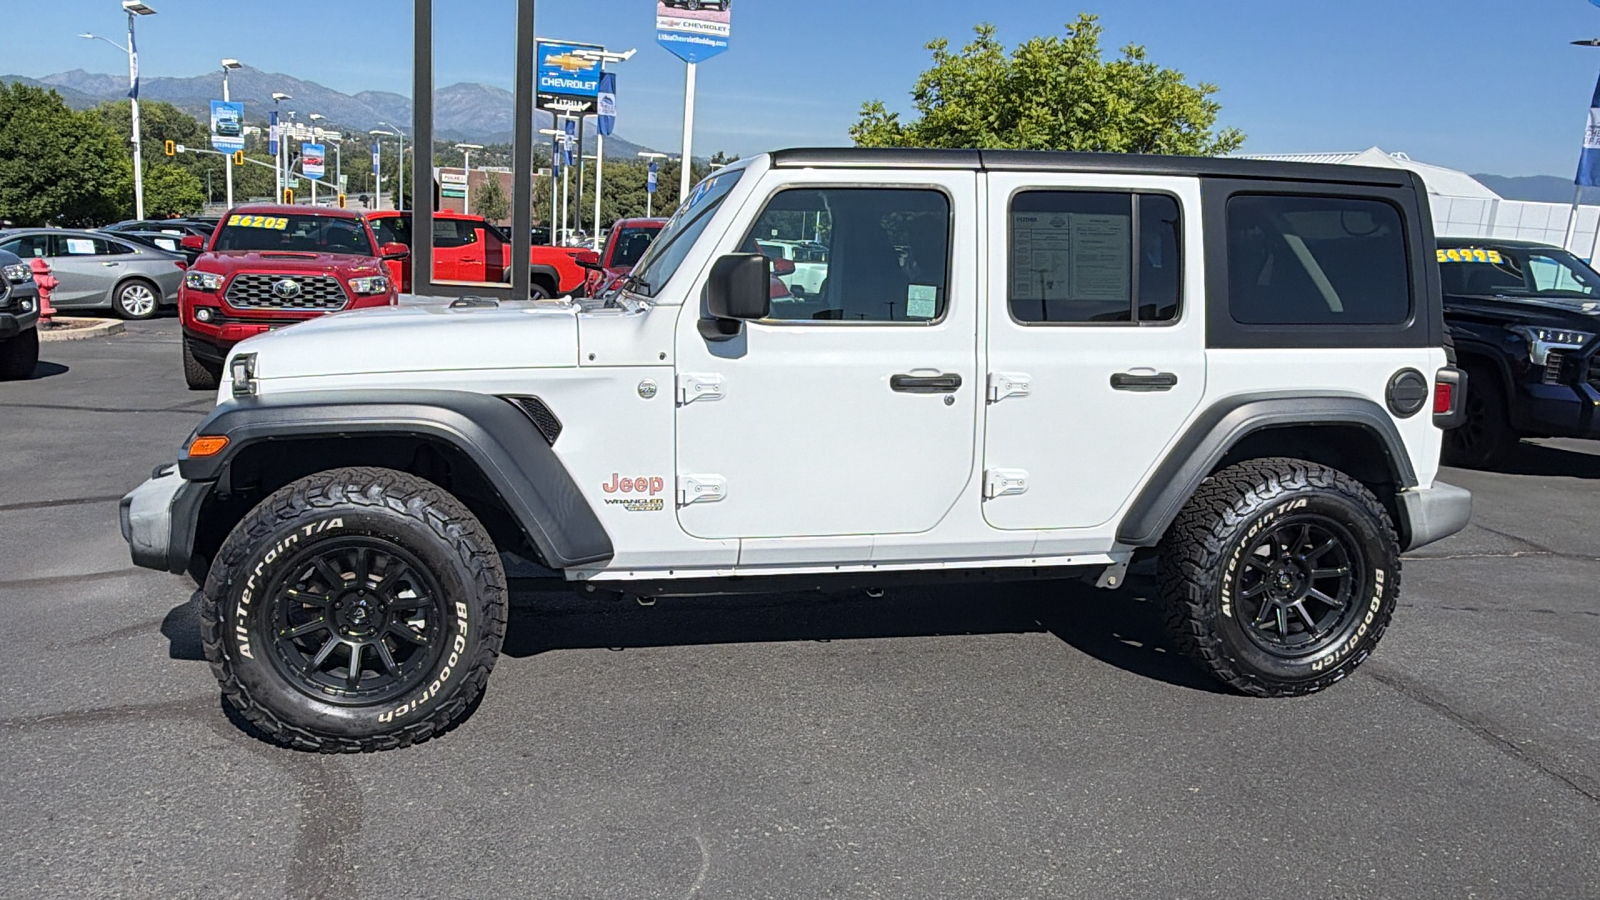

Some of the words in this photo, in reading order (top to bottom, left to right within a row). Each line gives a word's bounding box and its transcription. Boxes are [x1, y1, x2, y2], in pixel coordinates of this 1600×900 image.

[683, 21, 727, 32] CHEVROLET
[541, 77, 598, 91] CHEVROLET
[602, 472, 664, 496] Jeep
[235, 533, 299, 660] All-Terrain
[301, 517, 344, 537] T/A
[1221, 511, 1275, 618] All-Terrain
[1276, 498, 1307, 515] T/A
[377, 600, 468, 723] BFGoodrich
[1311, 567, 1386, 672] BFGoodrich
